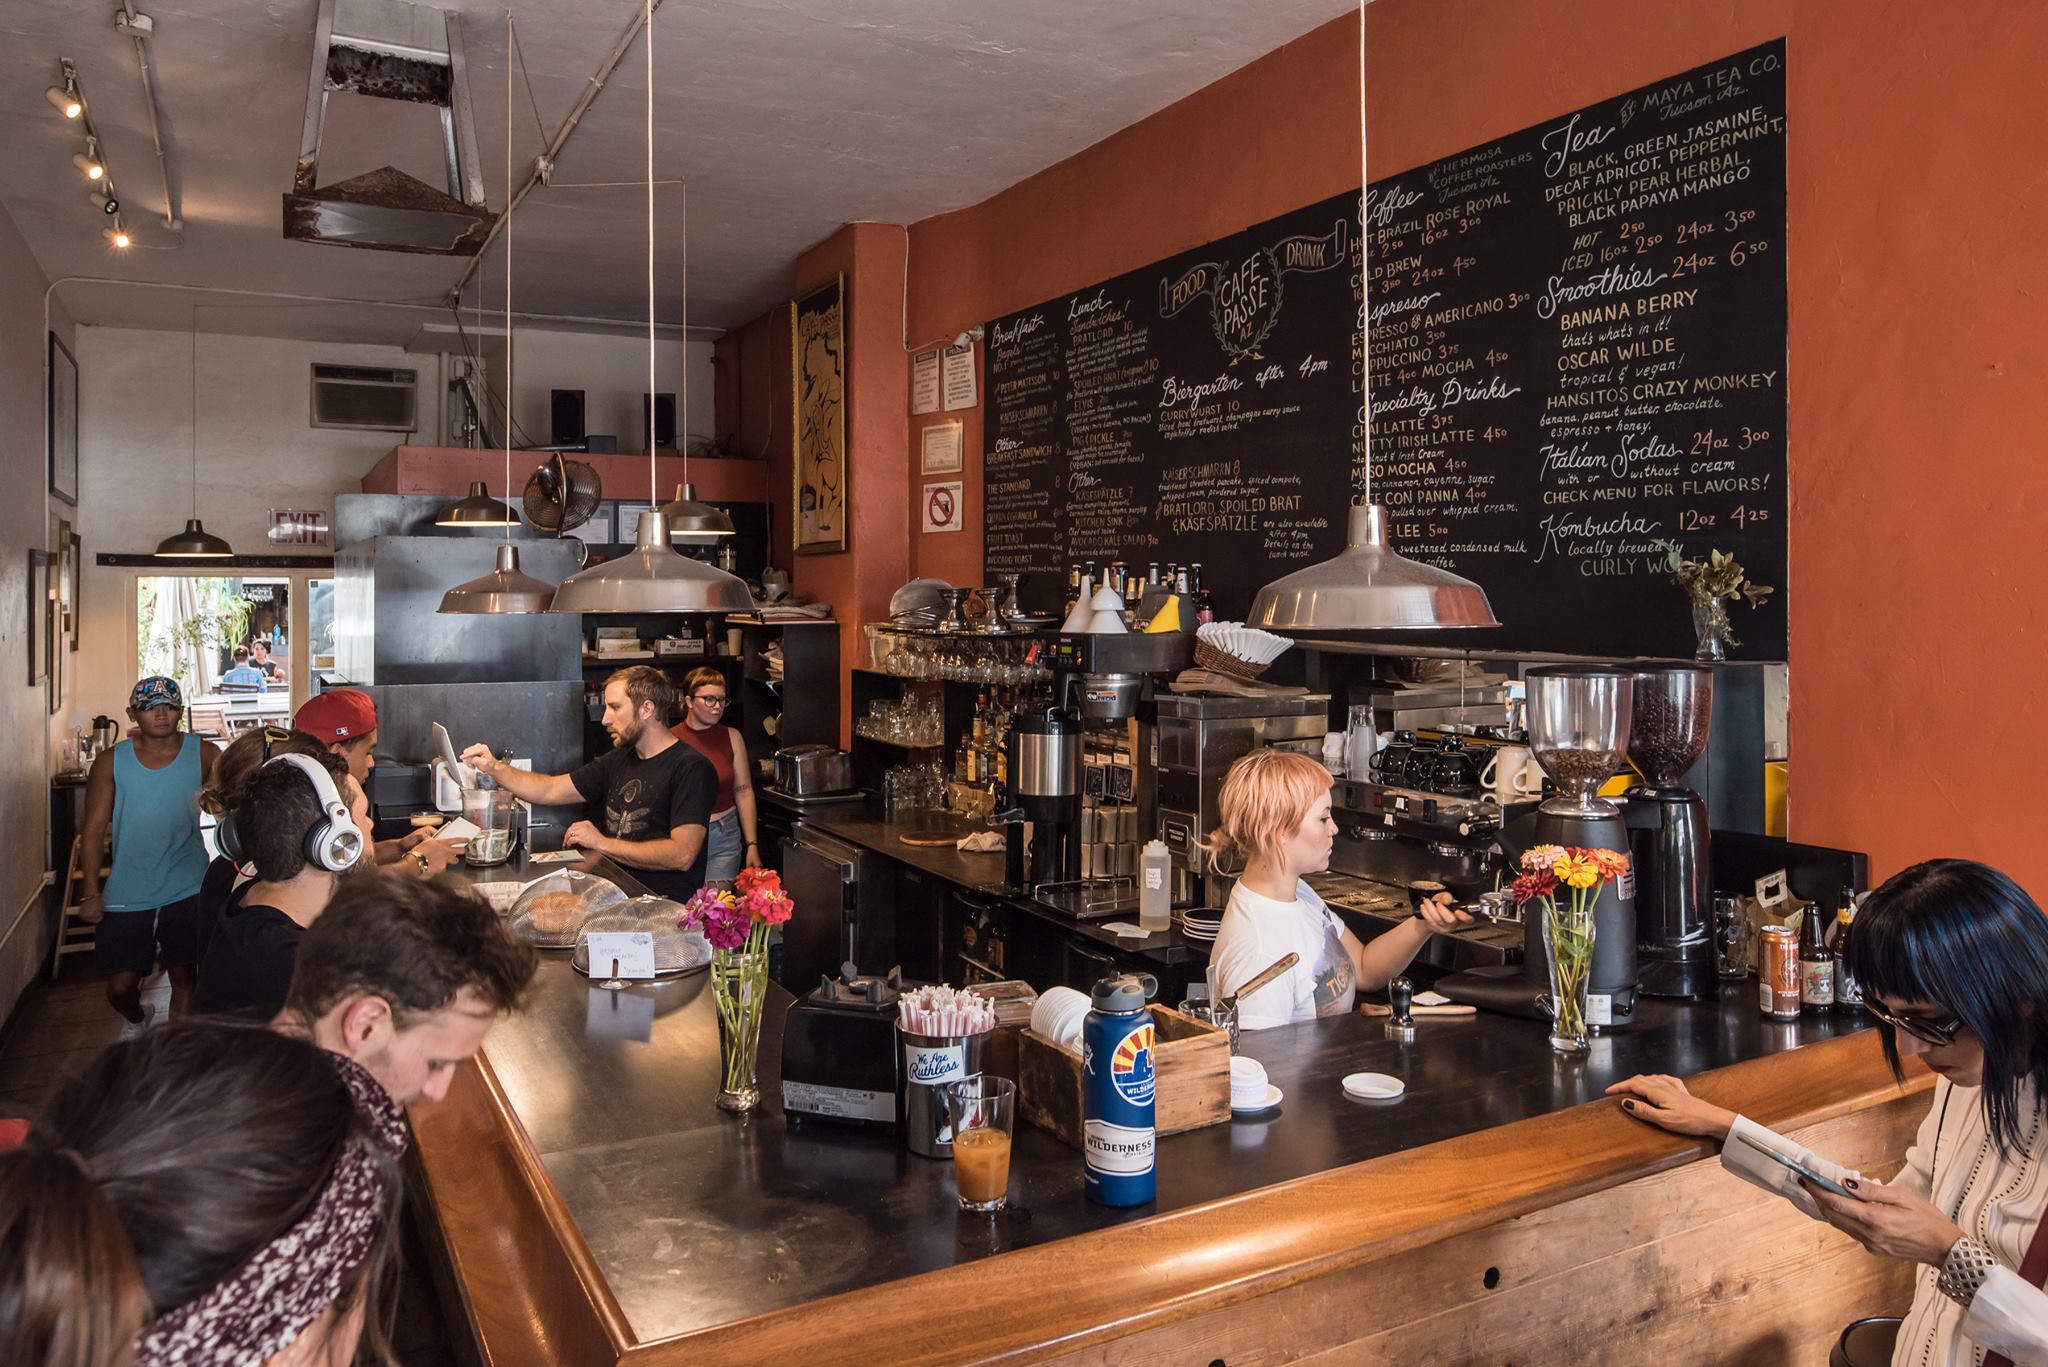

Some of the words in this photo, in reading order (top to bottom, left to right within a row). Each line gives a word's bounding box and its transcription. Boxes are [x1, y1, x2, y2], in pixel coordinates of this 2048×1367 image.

[1643, 82, 1693, 111] MAYA
[1703, 68, 1741, 89] TEA
[1750, 55, 1781, 75] CO.
[1660, 94, 1712, 121] Tucson
[1542, 114, 1615, 178] Tea
[1569, 152, 1618, 178] BLACK,
[1624, 133, 1677, 160] GREEN
[1683, 106, 1767, 143] JASMINE,
[1443, 147, 1501, 174] HERMOSA
[1545, 177, 1590, 201] DECAF
[1595, 156, 1661, 186] APRICOT,
[1669, 117, 1783, 164] PEPPERMINT,
[1433, 168, 1472, 189] COFFEE
[1476, 152, 1532, 176] ROASTERS
[1558, 185, 1623, 215] PRICKLY
[1630, 171, 1670, 195] PEAR
[1676, 151, 1750, 182] HERBAL,
[1358, 185, 1424, 226] Coffee
[1569, 206, 1616, 227] BLACK
[1621, 189, 1679, 214] PAPAYA
[1684, 166, 1750, 197] MANGO
[1378, 220, 1422, 244] BRAZIL
[1427, 206, 1461, 229] ROSE
[1466, 192, 1512, 216] ROYAL
[1562, 253, 1593, 273] ICED
[1676, 221, 1715, 244] 24oz
[1573, 231, 1602, 250] HOT
[1286, 242, 1326, 267] DRINK
[1387, 255, 1422, 278] BREW
[1412, 267, 1444, 287] 24oz
[1173, 269, 1206, 310] FOOD
[1221, 252, 1260, 307] CAFE
[1537, 262, 1668, 319] Smoothies
[1672, 253, 1716, 278] 24oz
[1068, 289, 1112, 321] Lunch
[1224, 277, 1269, 334] PASSE
[1357, 292, 1440, 329] Espresso
[1425, 298, 1503, 328] AMERICANO
[1561, 302, 1630, 330] BANANA
[1637, 289, 1698, 316] BERRY
[1070, 300, 1131, 335] Sandwiches!
[1124, 321, 1133, 331] 10
[991, 315, 1044, 349] Breakfast
[1562, 330, 1593, 348] that's
[1599, 324, 1633, 342] what's
[1639, 322, 1649, 335] in
[1654, 315, 1671, 331] it!
[1558, 348, 1609, 371] OSCAR
[1617, 338, 1676, 360] WILDE
[1422, 358, 1474, 378] MOCHA
[1560, 368, 1612, 388] tropical
[1635, 353, 1685, 380] vegan!
[1159, 373, 1243, 410] Biergarten
[1256, 365, 1284, 389] after
[1299, 354, 1328, 378] 4pm
[1547, 388, 1629, 410] HANSITOS
[1633, 380, 1688, 400] CRAZY
[1694, 371, 1776, 393] MONKEY
[1074, 400, 1093, 410] ELVIS
[1357, 386, 1436, 423] Specialty
[1443, 376, 1521, 409] Drinks
[1161, 404, 1222, 422] CURRYWURST
[1228, 400, 1240, 412] 10
[1226, 410, 1261, 423] champagne
[1263, 408, 1281, 418] curry
[1540, 413, 1580, 426] banana,
[1582, 408, 1619, 423] peanut
[1624, 403, 1659, 415] butter,
[1384, 418, 1425, 434] LATTE
[1551, 426, 1600, 439] espresso
[995, 438, 1024, 453] Other
[1089, 432, 1114, 444] PICKLE
[1398, 435, 1429, 449] IRISH
[1433, 430, 1475, 444] LATTE
[987, 450, 1018, 464] BREAKFAST
[1018, 446, 1052, 459] SANDWICH
[1418, 449, 1444, 459] Cream
[1540, 442, 1608, 481] Italian
[1611, 434, 1682, 478] Sodas
[1691, 429, 1729, 456] 24oz
[1233, 459, 1240, 475] 8
[1388, 462, 1436, 475] MOCHA
[1558, 474, 1579, 485] with
[1588, 474, 1599, 482] or
[1630, 463, 1679, 479] without
[1691, 460, 1735, 473] cream
[988, 484, 998, 494] THE
[1000, 479, 1031, 493] STANDARD
[1068, 472, 1102, 494] Other
[1424, 475, 1465, 486] cayenne,
[1544, 491, 1589, 504] CHECK
[1593, 487, 1636, 501] MENU
[1645, 483, 1674, 497] FOR
[1682, 474, 1770, 494] FLAVORS!
[1208, 487, 1236, 498] powdered
[1386, 490, 1413, 505] CON
[1418, 489, 1459, 503] PANNA
[1163, 503, 1216, 517] BRATLORD,
[1220, 498, 1265, 514] SPOILED
[1270, 495, 1301, 512] BRAT
[1391, 506, 1415, 520] pulled
[1417, 508, 1436, 516] over
[1443, 503, 1479, 520] whipped
[276, 513, 320, 543] EXIT
[1076, 517, 1104, 528] KITCHEN
[1107, 516, 1123, 526] SINK
[1263, 521, 1275, 529] are
[1278, 519, 1293, 528] also
[1295, 518, 1327, 528] available
[1397, 524, 1421, 538] LEE
[1006, 533, 1023, 544] TOAST
[1104, 536, 1120, 545] KALE
[1123, 534, 1145, 544] SALAD
[1264, 540, 1289, 550] Details
[1302, 539, 1313, 550] the
[1400, 542, 1447, 553] sweetened
[1451, 540, 1500, 553] condensed
[1534, 512, 1661, 563] Kombucha
[1680, 510, 1716, 530] 12oz
[1014, 554, 1032, 563] TOAST
[1568, 541, 1613, 558] locally
[1618, 539, 1662, 553] brewed
[1581, 557, 1637, 576] CURLY
[153, 680, 168, 693] A
[910, 1059, 959, 1079] Ruthless
[917, 1054, 928, 1064] We
[1088, 1138, 1151, 1152] WILDERNESS
